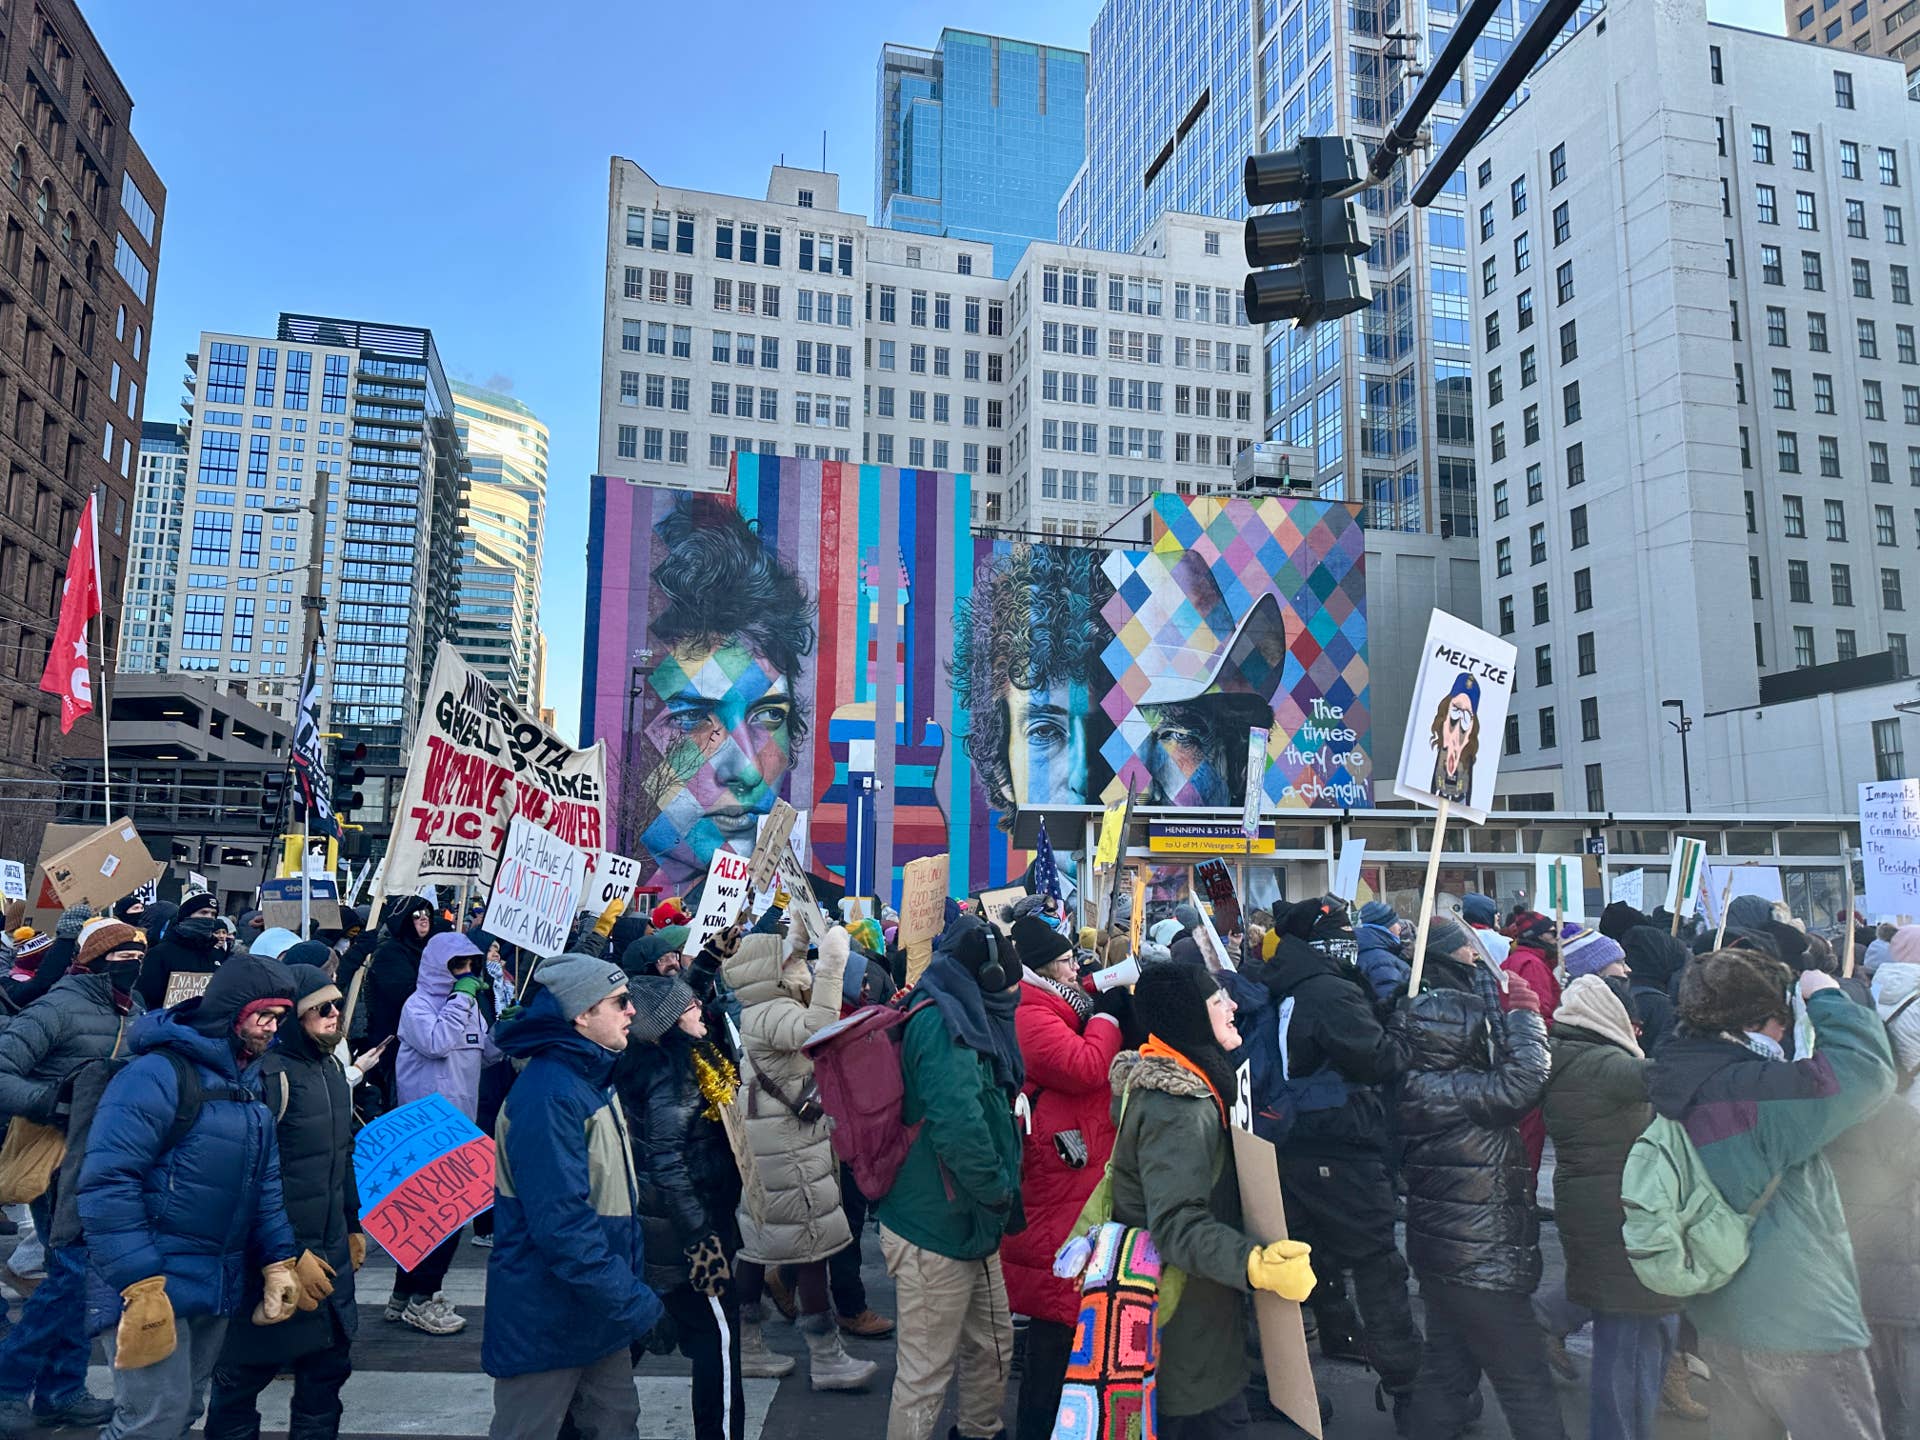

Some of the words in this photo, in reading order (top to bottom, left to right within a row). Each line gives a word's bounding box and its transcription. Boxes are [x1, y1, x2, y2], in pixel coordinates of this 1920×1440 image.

[1435, 645, 1480, 672] MELT
[1480, 663, 1508, 685] ICE
[1310, 697, 1343, 720] The
[1300, 720, 1357, 742] times
[1285, 744, 1327, 773] they
[1332, 751, 1364, 766] are
[1282, 776, 1369, 805] a-changin'
[1865, 811, 1878, 819] are
[1882, 807, 1897, 819] not
[1903, 806, 1919, 820] the
[1165, 826, 1206, 835] HENNEPIN
[1207, 826, 1213, 835] &
[1215, 827, 1230, 835] 5TH
[515, 824, 535, 863] WE
[535, 833, 561, 875] HAVE
[560, 850, 575, 887] A
[1174, 841, 1181, 849] U
[1191, 842, 1198, 850] M
[1203, 843, 1234, 851] Westgate
[1236, 842, 1260, 850] Staon
[1866, 841, 1885, 854] The
[609, 857, 632, 878] ICE
[714, 857, 748, 880] ALEX
[497, 857, 578, 927] CONSTITUTION
[602, 882, 630, 902] OUT
[718, 885, 739, 898] WAS
[717, 902, 726, 912] A
[493, 903, 522, 931] NOT
[518, 913, 529, 936] A
[532, 916, 564, 951] KING
[703, 914, 727, 928] KIND
[422, 1119, 473, 1157] NOT
[371, 1137, 496, 1244] IGNORANCE
